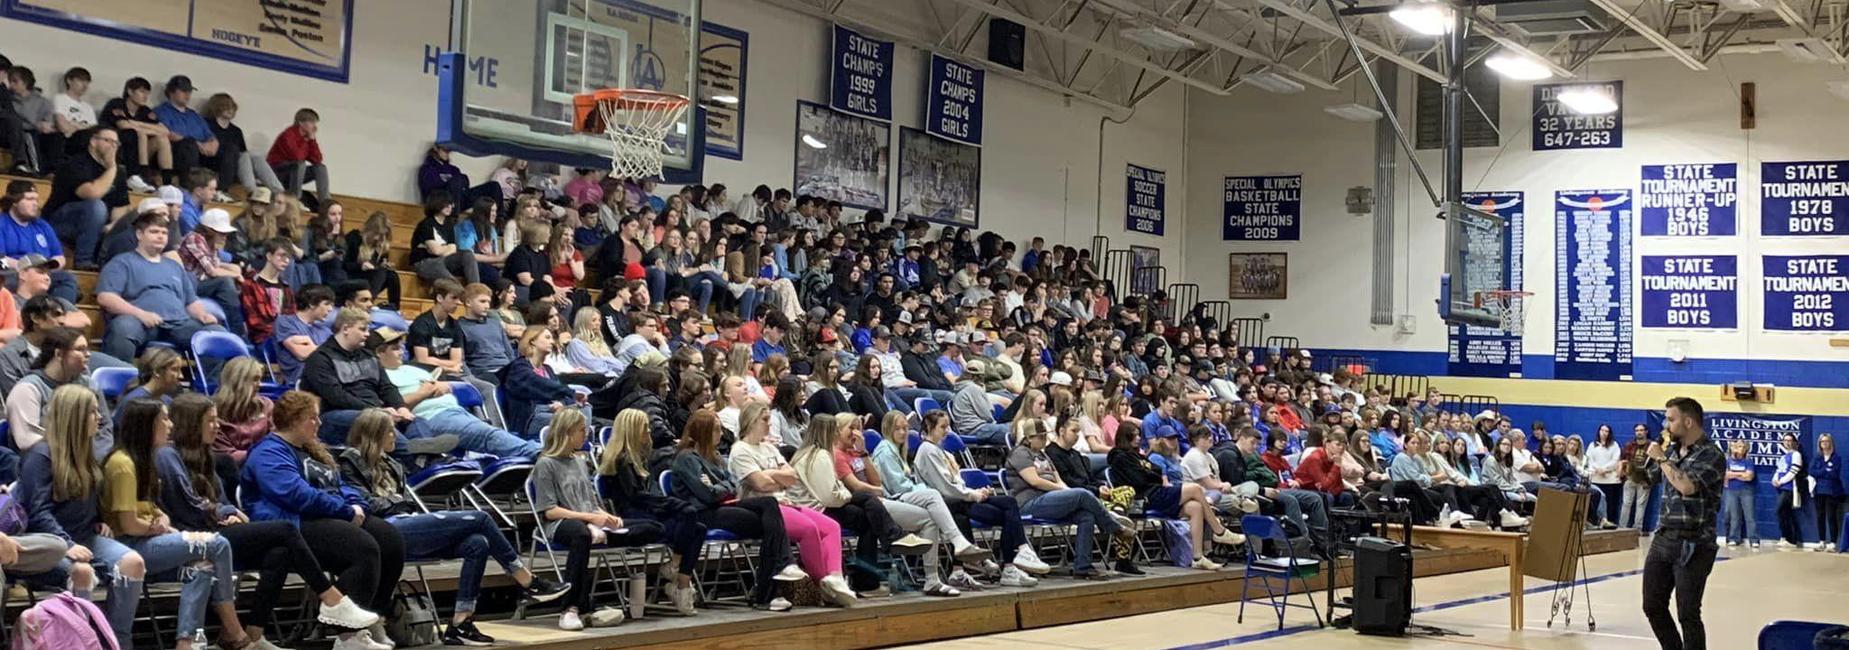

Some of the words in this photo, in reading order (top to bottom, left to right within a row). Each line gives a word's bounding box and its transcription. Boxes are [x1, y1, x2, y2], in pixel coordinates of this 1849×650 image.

[212, 28, 261, 48] HOGEYE
[849, 35, 880, 58] STATE
[423, 44, 498, 88] HME
[843, 53, 884, 77] CHAMPS
[945, 63, 973, 85] STATE
[850, 74, 875, 95] 1999
[940, 80, 976, 103] CHAMPS
[847, 93, 877, 113] GIRLS
[943, 100, 969, 120] 2004
[941, 118, 969, 138] GIRLS
[1540, 118, 1558, 131] 32
[1564, 116, 1615, 130] YEARS
[1544, 131, 1611, 146] 647-263
[1663, 165, 1714, 179] STATE
[1785, 165, 1838, 180] STATE
[1134, 180, 1157, 195] SOCCER
[1225, 178, 1257, 190] SPECIAL
[1263, 177, 1301, 189] OLYMPICS
[1642, 178, 1736, 193] TOURNAMENT
[1762, 182, 1849, 198] TOURNAMEN
[1136, 193, 1155, 208] STATE
[1225, 190, 1299, 201] BASKETBALL
[1641, 193, 1736, 208] RUNNER-UP
[1128, 204, 1161, 221] CHAMPIONS
[1245, 202, 1279, 214] STATE
[1667, 207, 1709, 222] 1946
[1790, 200, 1832, 215] 1978
[1230, 215, 1293, 226] CHAMPIONS
[1789, 218, 1834, 232] BOYS
[1244, 227, 1278, 239] 2009
[1667, 222, 1709, 236] BOYS
[1664, 259, 1713, 273] STATE
[1787, 259, 1838, 274] STATE
[1642, 275, 1736, 291] TOURNAMENT
[1764, 276, 1849, 292] TOURNAMEN
[1670, 293, 1707, 308] 2011
[1793, 294, 1832, 309] 2012
[1667, 310, 1710, 324] BOYS
[1791, 312, 1834, 327] BOYS
[1711, 418, 1800, 430] LIVINGSTON
